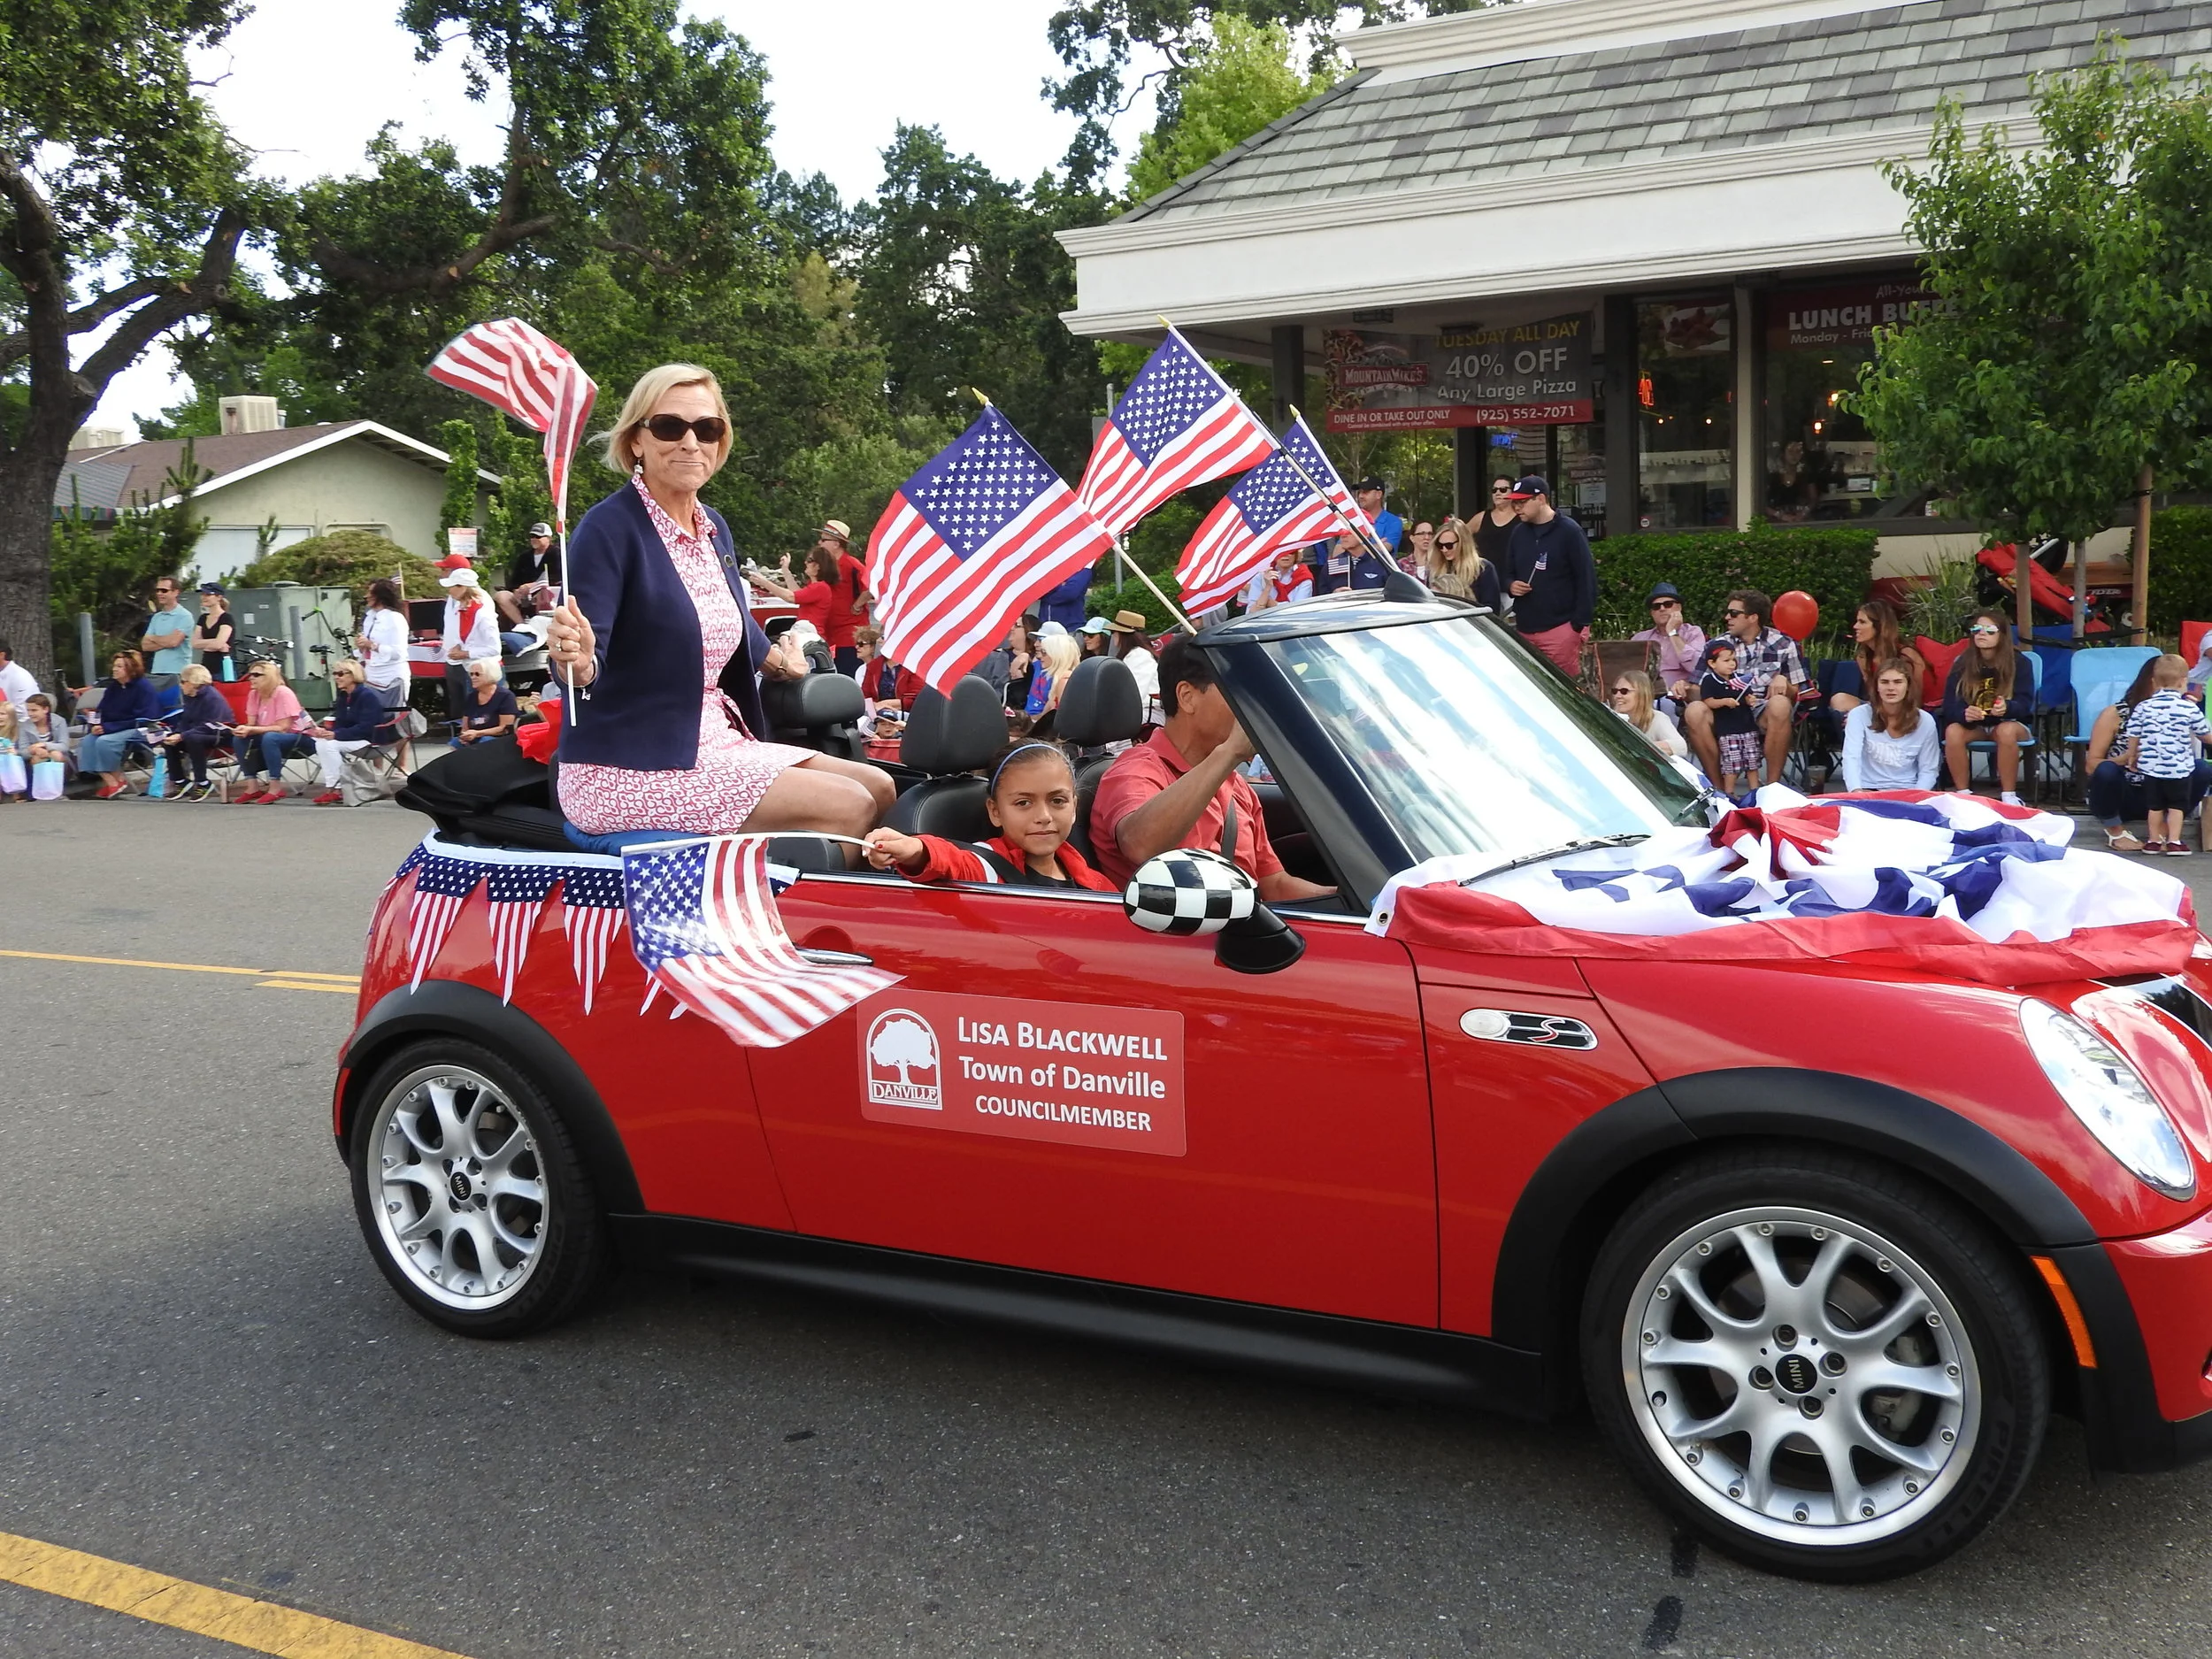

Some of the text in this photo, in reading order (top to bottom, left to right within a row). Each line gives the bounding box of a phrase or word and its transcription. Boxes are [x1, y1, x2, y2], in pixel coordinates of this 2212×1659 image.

[1788, 304, 1871, 331] LUNCH
[1512, 324, 1541, 343] ALL
[1547, 320, 1581, 340] DAY
[1790, 330, 1839, 345] Monday
[1446, 347, 1568, 379] 40% OFF
[1437, 385, 1471, 403] Any
[1477, 382, 1526, 401] Large
[1532, 379, 1577, 396] Pizza
[1333, 409, 1450, 424] DINE IN OR TAKE OUT ONLY
[1476, 404, 1575, 424] (925) 552-7071
[957, 1016, 1168, 1061] LISA BLACKWELL
[958, 1056, 1166, 1099] Town of Danville
[872, 1083, 939, 1105] DANVILLE
[975, 1094, 1152, 1132] COUNCILMEMBER
[455, 1175, 467, 1197] MINI
[1787, 1359, 1805, 1389] MINI
